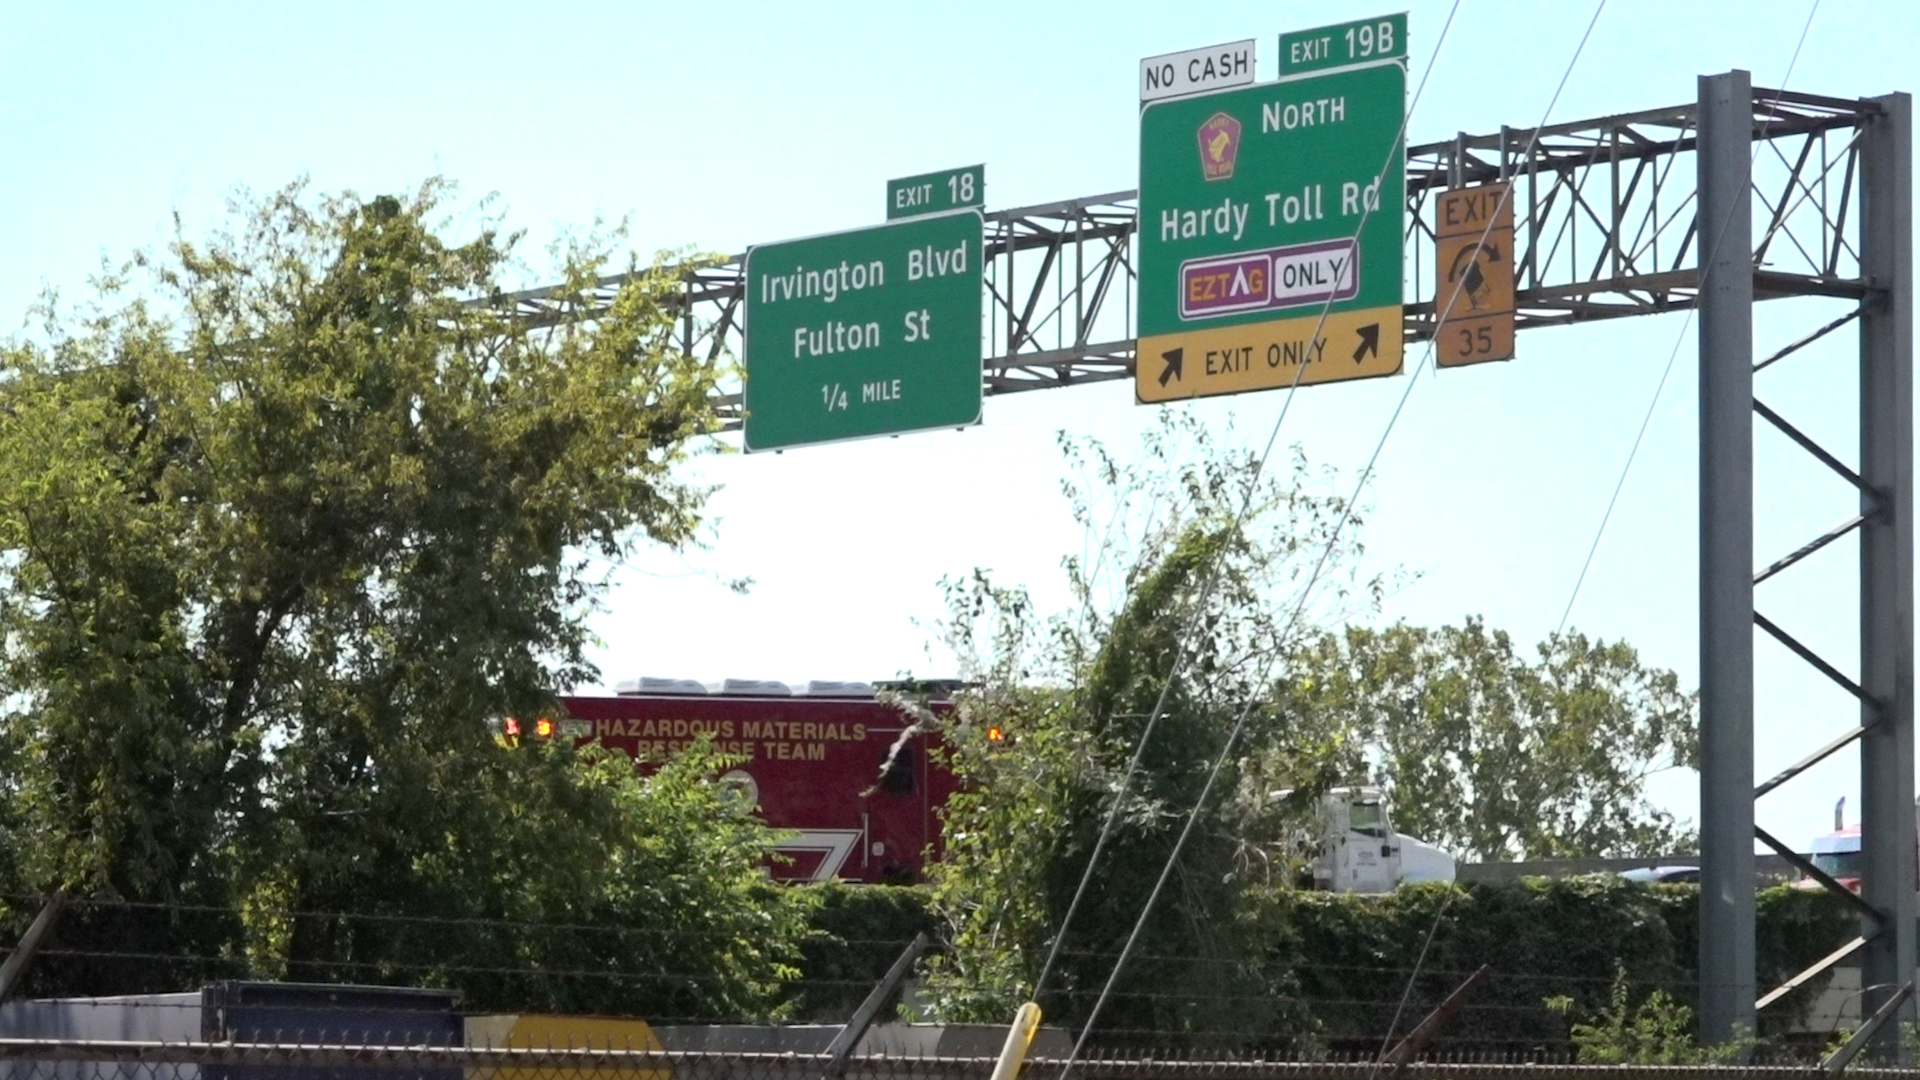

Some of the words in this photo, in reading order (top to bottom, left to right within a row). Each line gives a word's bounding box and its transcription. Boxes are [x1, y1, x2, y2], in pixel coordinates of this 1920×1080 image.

[1291, 37, 1331, 63] EXIT
[1345, 22, 1394, 58] 19B
[1146, 64, 1174, 90] NO
[1188, 50, 1248, 82] CASH
[1263, 97, 1345, 133] NORTH
[896, 184, 933, 209] EXIT
[947, 173, 975, 204] 18
[1161, 198, 1249, 241] Hardy
[1265, 184, 1323, 226] Toll
[1342, 176, 1380, 216] Rd
[1446, 191, 1503, 226] EXIT
[761, 260, 884, 303] Irvington
[908, 240, 967, 281] Blvd
[1190, 265, 1264, 301] EZTAG
[1283, 257, 1344, 288] ONLY
[795, 321, 880, 358] Fulton
[904, 309, 930, 343] St
[1458, 326, 1492, 357] 35
[1206, 346, 1253, 376] EXIT
[1267, 338, 1328, 368] ONLY
[821, 383, 848, 412] 1/4
[862, 379, 901, 403] MILE
[596, 719, 735, 738] HAZARDOUS
[743, 721, 867, 741] MATERIALS
[638, 740, 755, 761] RESPNSE
[764, 742, 826, 761] TEAM
